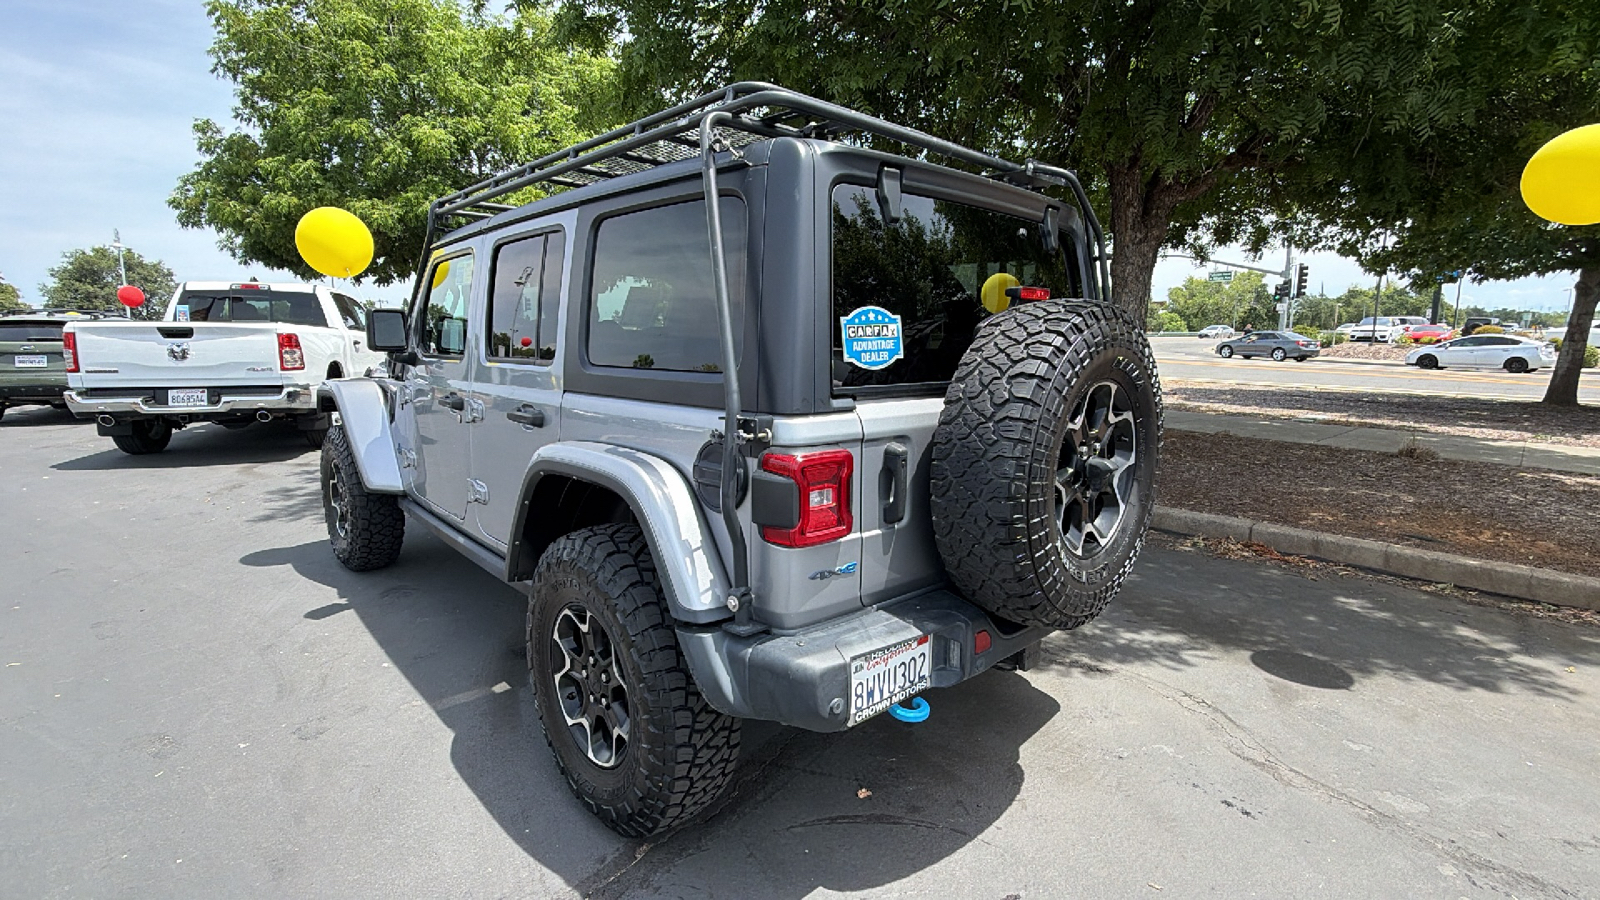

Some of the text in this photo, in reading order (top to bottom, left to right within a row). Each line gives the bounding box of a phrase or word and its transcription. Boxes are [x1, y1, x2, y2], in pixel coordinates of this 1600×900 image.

[847, 325, 896, 338] CARFAX
[853, 339, 896, 351] ADVANTAGE
[861, 351, 889, 362] DEALER
[854, 651, 927, 711] 8WVU302
[855, 679, 928, 722] CROWN MOTORS
